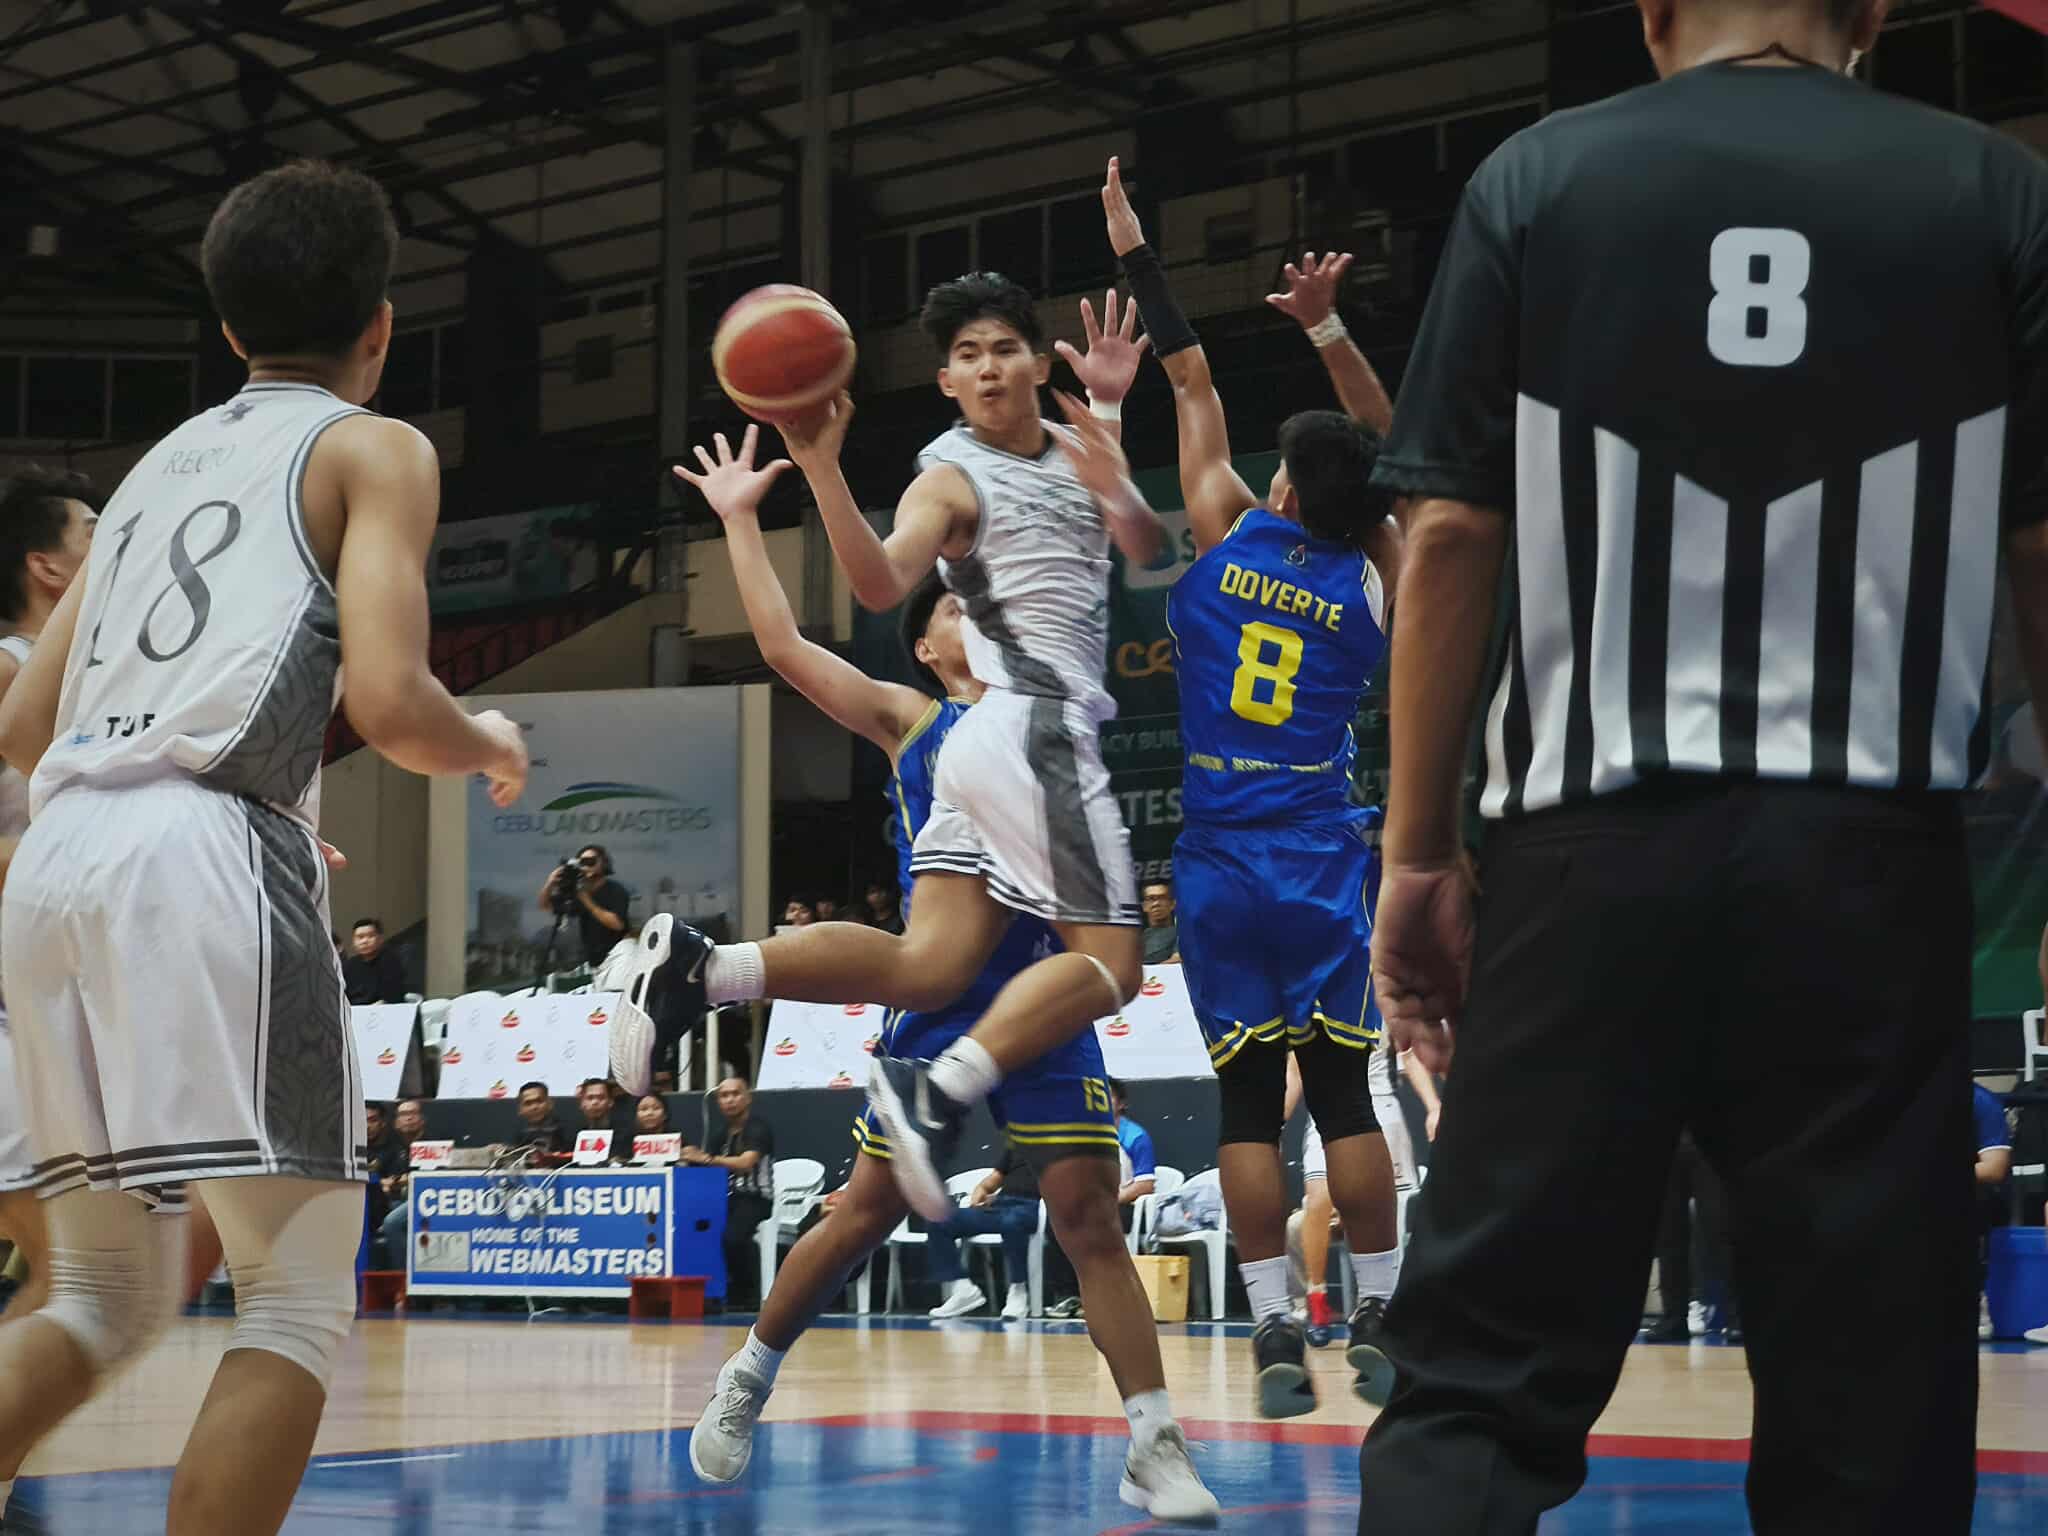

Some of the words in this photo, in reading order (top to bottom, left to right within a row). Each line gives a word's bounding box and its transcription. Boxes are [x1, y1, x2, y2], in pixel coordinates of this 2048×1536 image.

[1707, 227, 1810, 367] 8
[87, 500, 241, 668] 18
[1219, 562, 1344, 632] DOVERTE
[1230, 620, 1304, 727] 8
[1082, 1076, 1109, 1113] 15
[472, 1227, 518, 1244] HOME
[521, 1227, 545, 1244] OF
[547, 1228, 580, 1244] THE
[472, 1248, 665, 1275] WEBMASTERS
